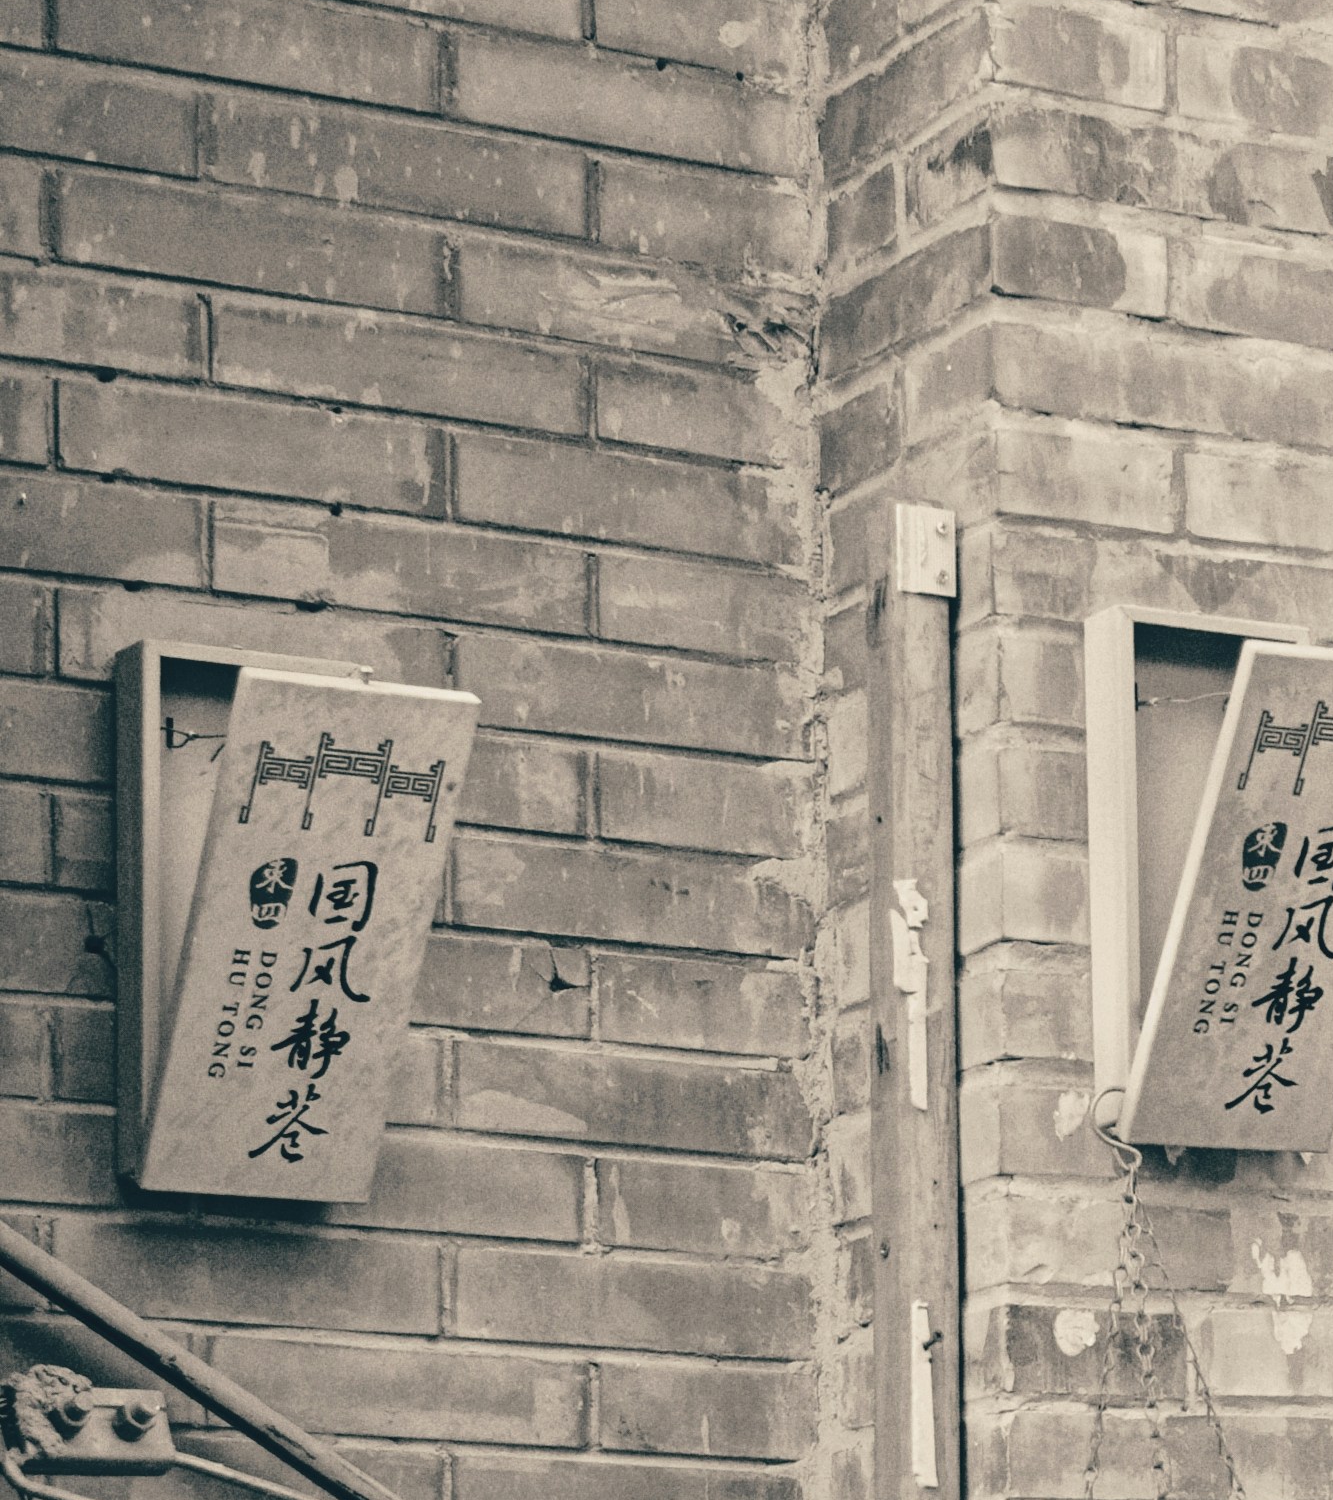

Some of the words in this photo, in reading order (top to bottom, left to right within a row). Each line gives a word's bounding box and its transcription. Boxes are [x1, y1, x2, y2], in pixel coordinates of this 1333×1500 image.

[1218, 909, 1240, 946] HU
[1230, 910, 1264, 990] DONG
[228, 947, 252, 987] HU
[246, 950, 280, 1032] DONG
[1193, 959, 1228, 1035] TONG
[207, 1000, 240, 1081] TONG
[248, 860, 379, 1164] 国风静巷
[1219, 1002, 1240, 1027] SI
[237, 1044, 258, 1070] SI
